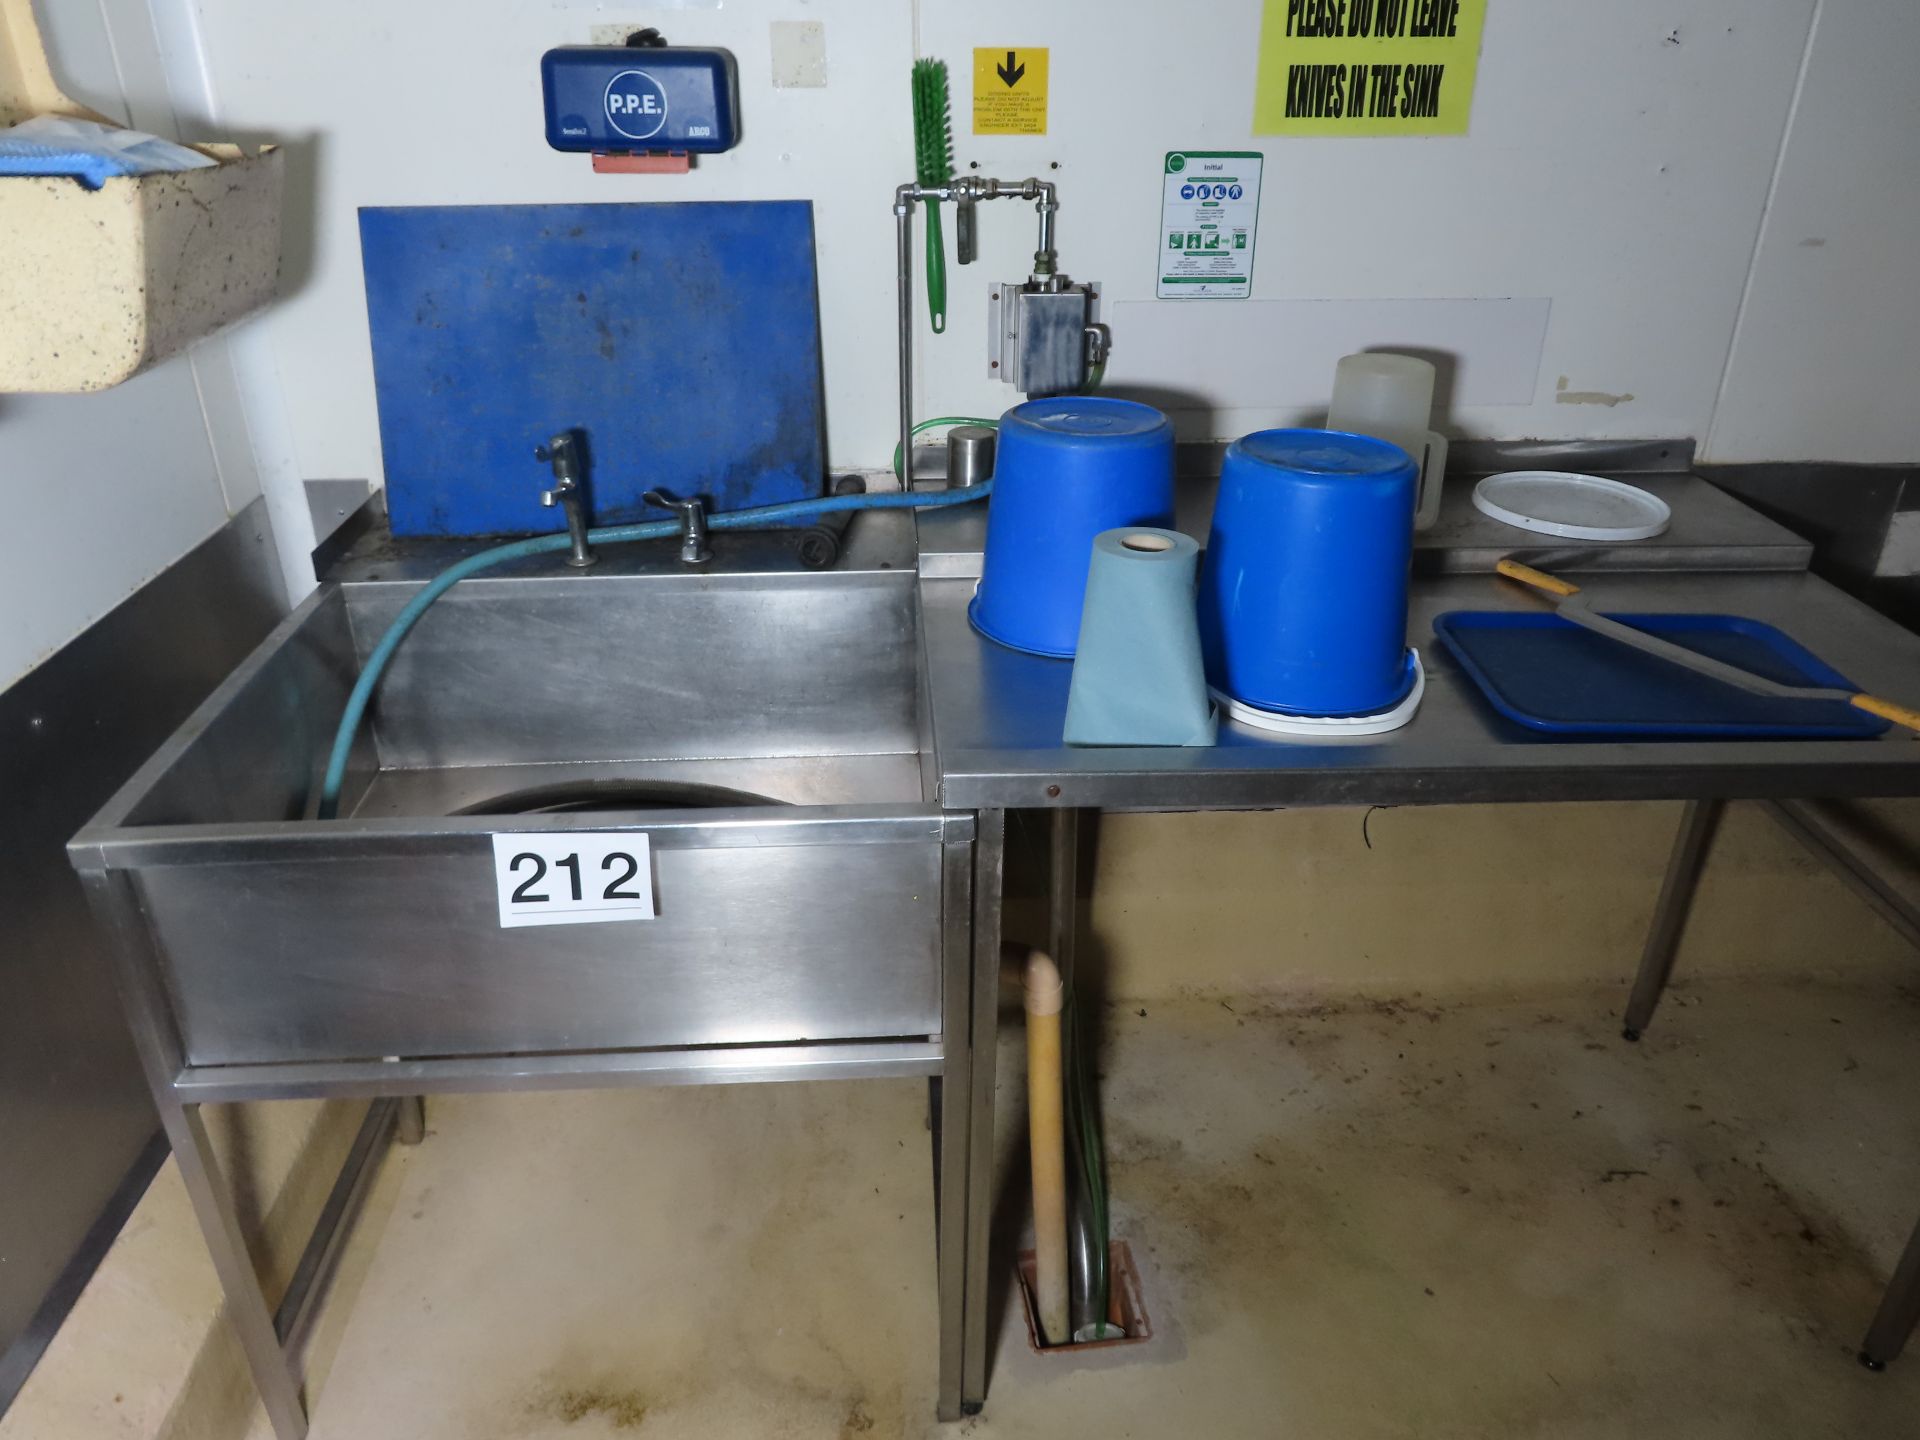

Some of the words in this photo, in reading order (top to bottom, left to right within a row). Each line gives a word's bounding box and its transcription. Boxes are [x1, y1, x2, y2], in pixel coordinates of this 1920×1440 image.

[1286, 0, 1346, 38] PLEASE
[1347, 0, 1374, 38] DO
[1374, 0, 1408, 38] NOT
[1410, 0, 1459, 38] LEAVE
[609, 94, 662, 114] P.P.E.
[1285, 64, 1347, 118] KNIVES
[1347, 64, 1368, 118] IN
[1369, 64, 1401, 118] THE
[1400, 64, 1444, 118] SINK
[688, 126, 710, 137] ARCO
[509, 852, 641, 903] 212
